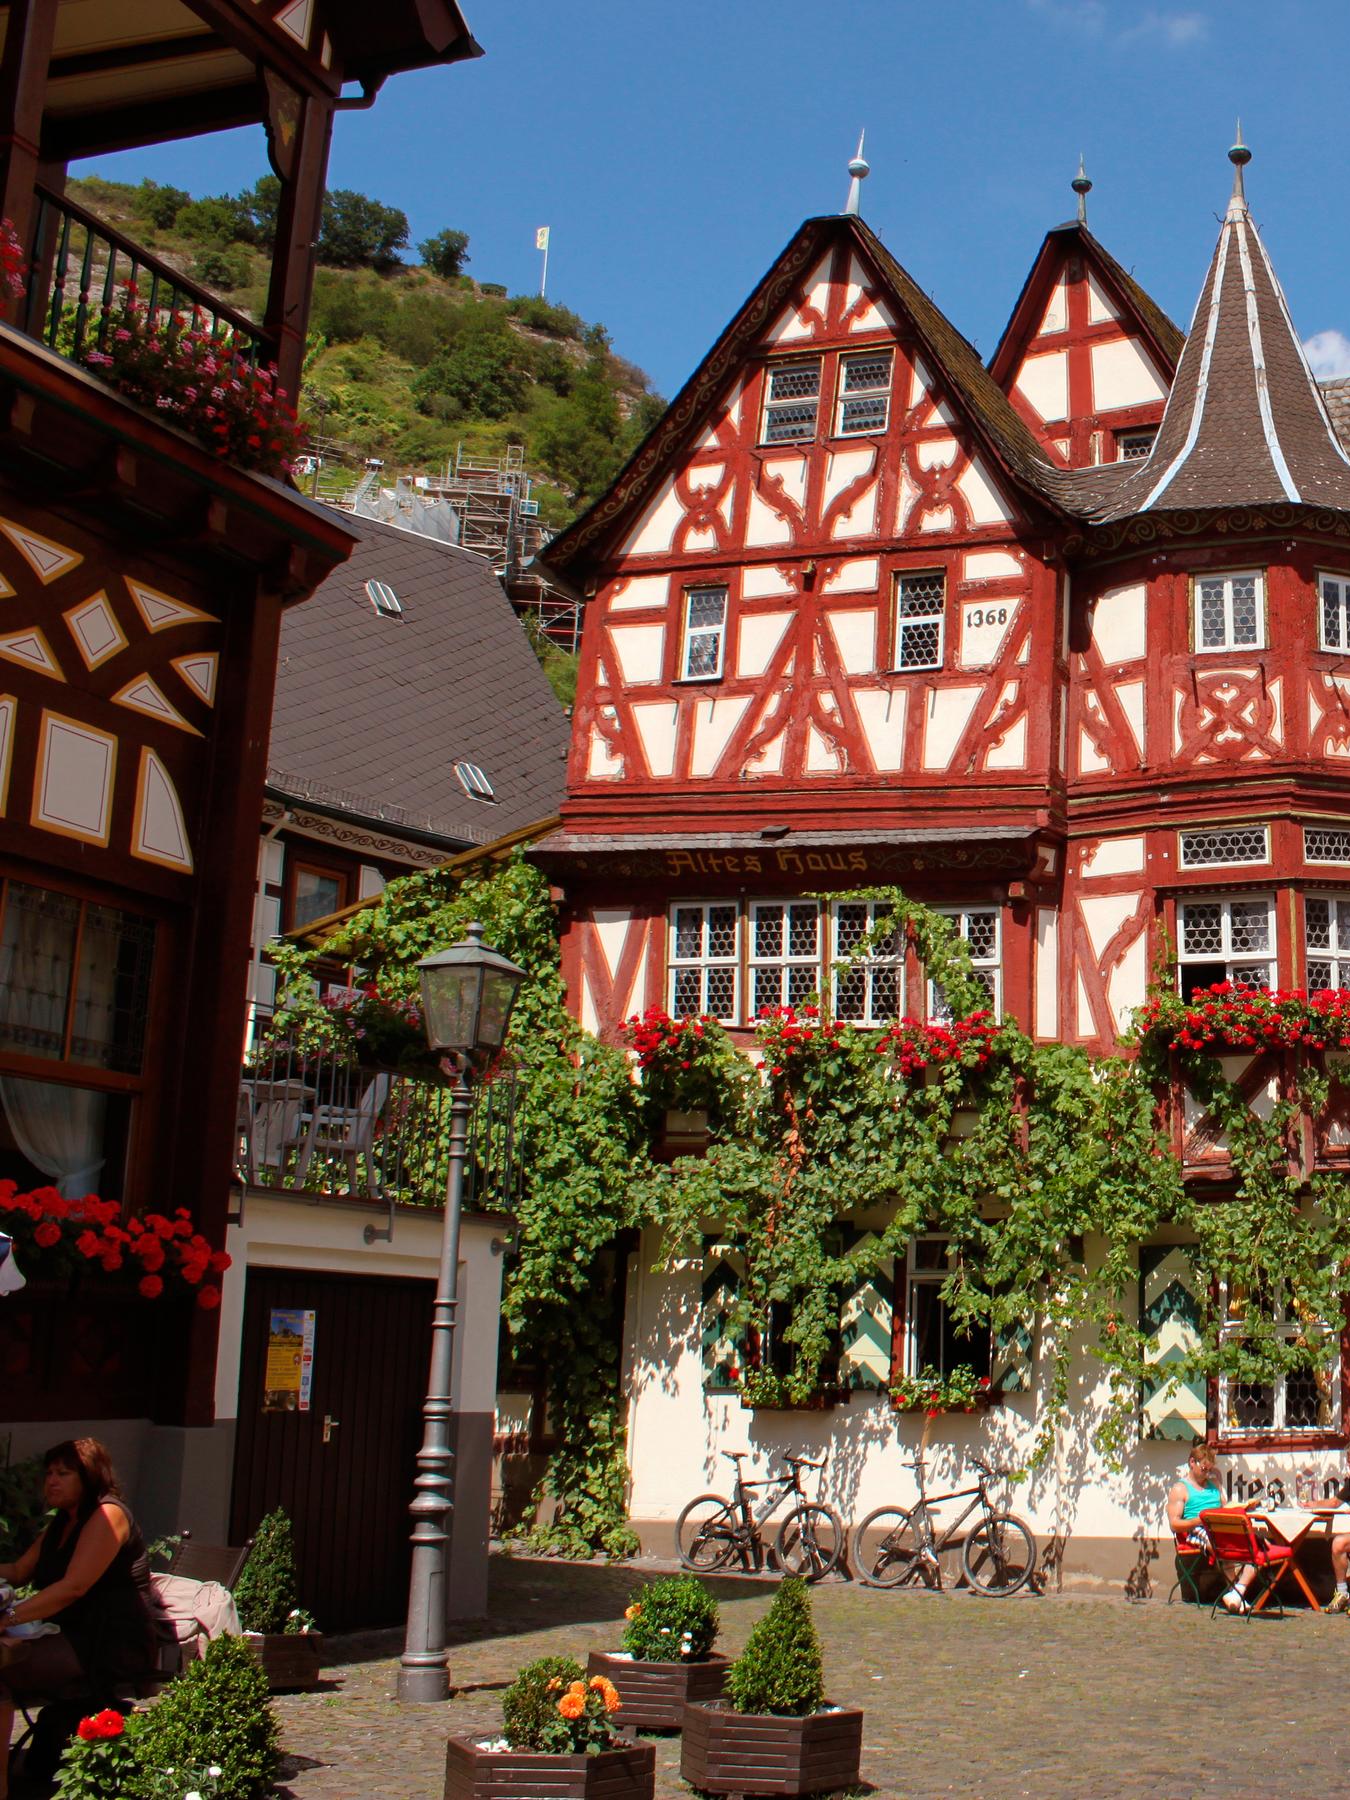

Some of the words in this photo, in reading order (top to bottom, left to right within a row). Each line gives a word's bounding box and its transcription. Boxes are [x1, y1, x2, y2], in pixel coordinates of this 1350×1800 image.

[967, 608, 1007, 628] 1368
[664, 850, 762, 877] Altes
[775, 848, 868, 875] Haus
[1226, 1469, 1285, 1503] ltes
